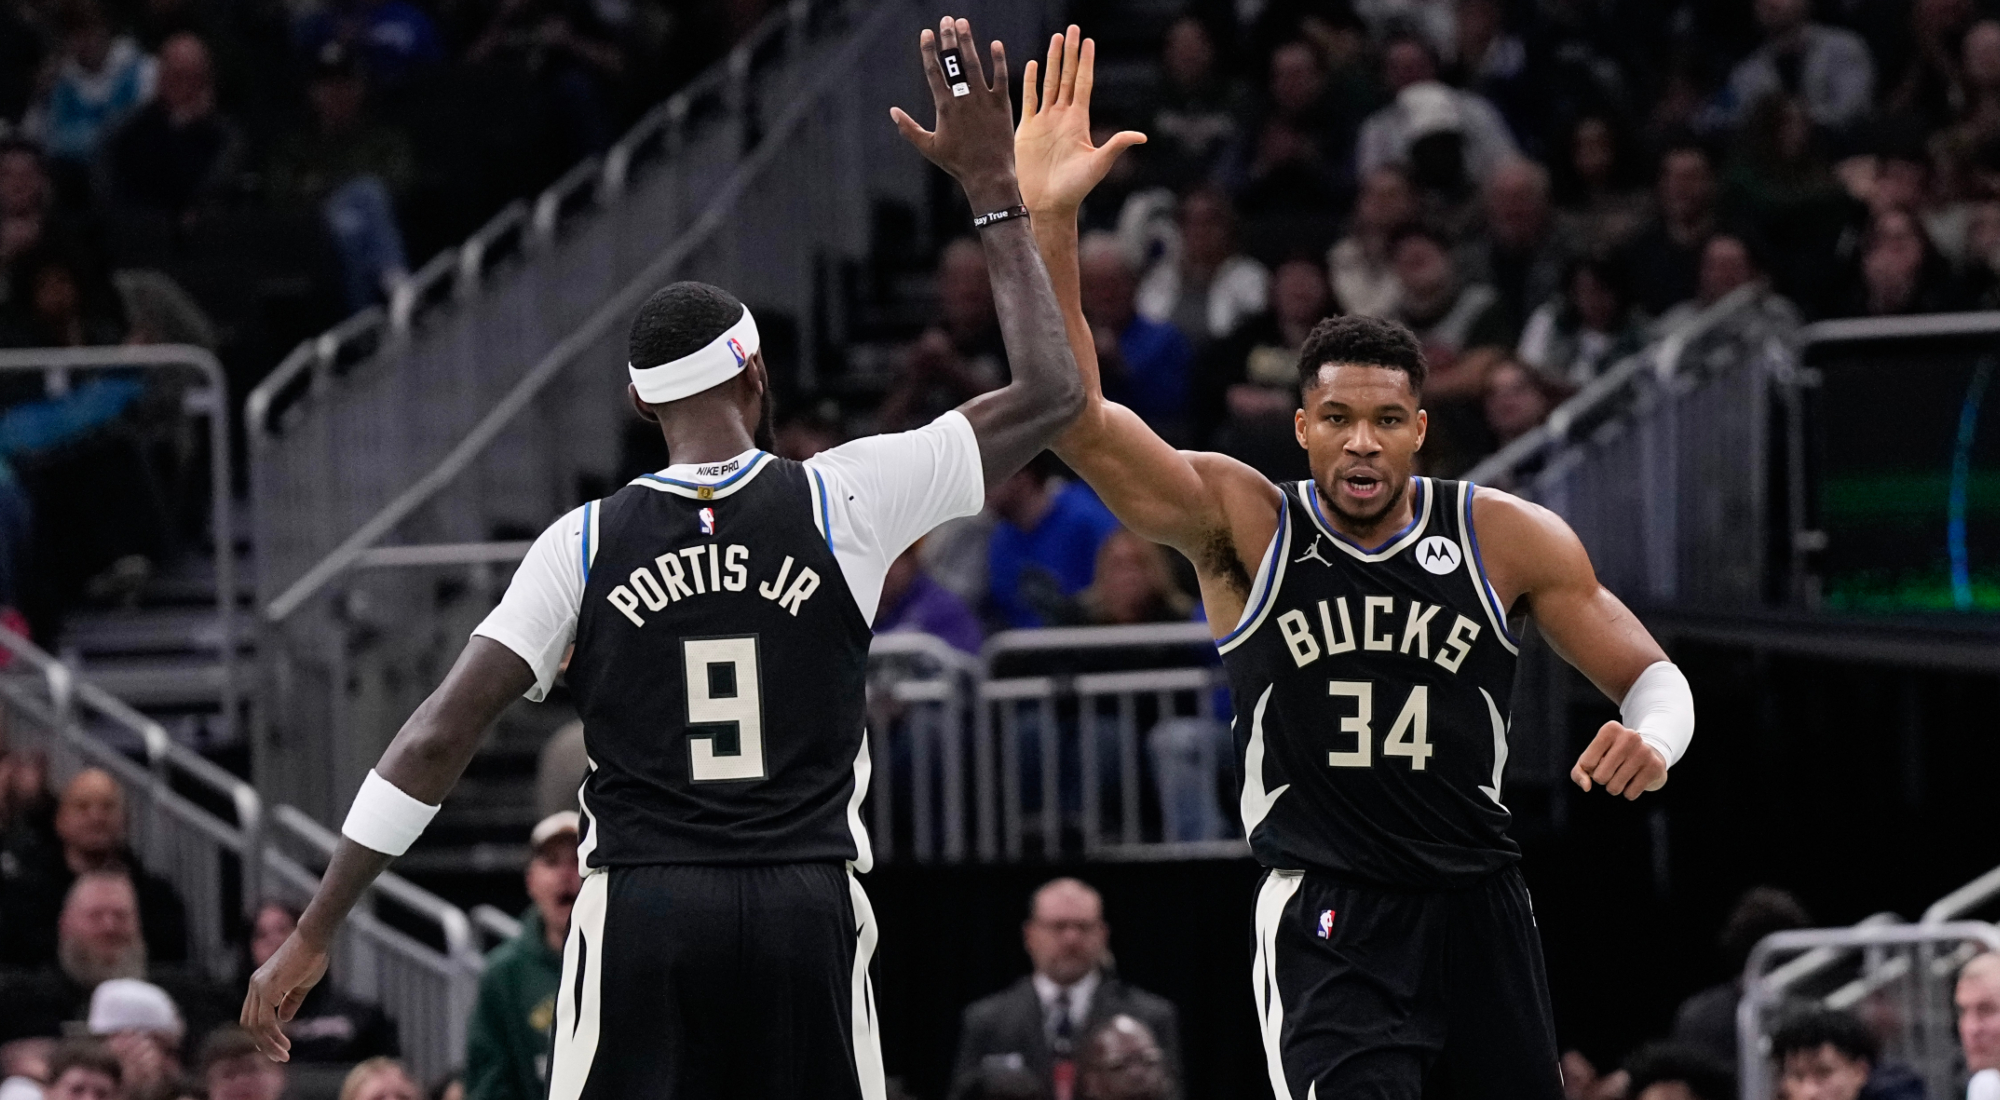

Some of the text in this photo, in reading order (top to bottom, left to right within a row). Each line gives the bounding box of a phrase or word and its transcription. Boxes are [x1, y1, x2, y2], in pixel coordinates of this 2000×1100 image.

[944, 55, 960, 77] 6
[987, 210, 1009, 221] True
[696, 460, 740, 476] NIKE PRO
[606, 543, 821, 628] PORTIS JR
[1275, 595, 1482, 675] BUCKS
[681, 634, 767, 783] 9
[1328, 680, 1434, 771] 34
